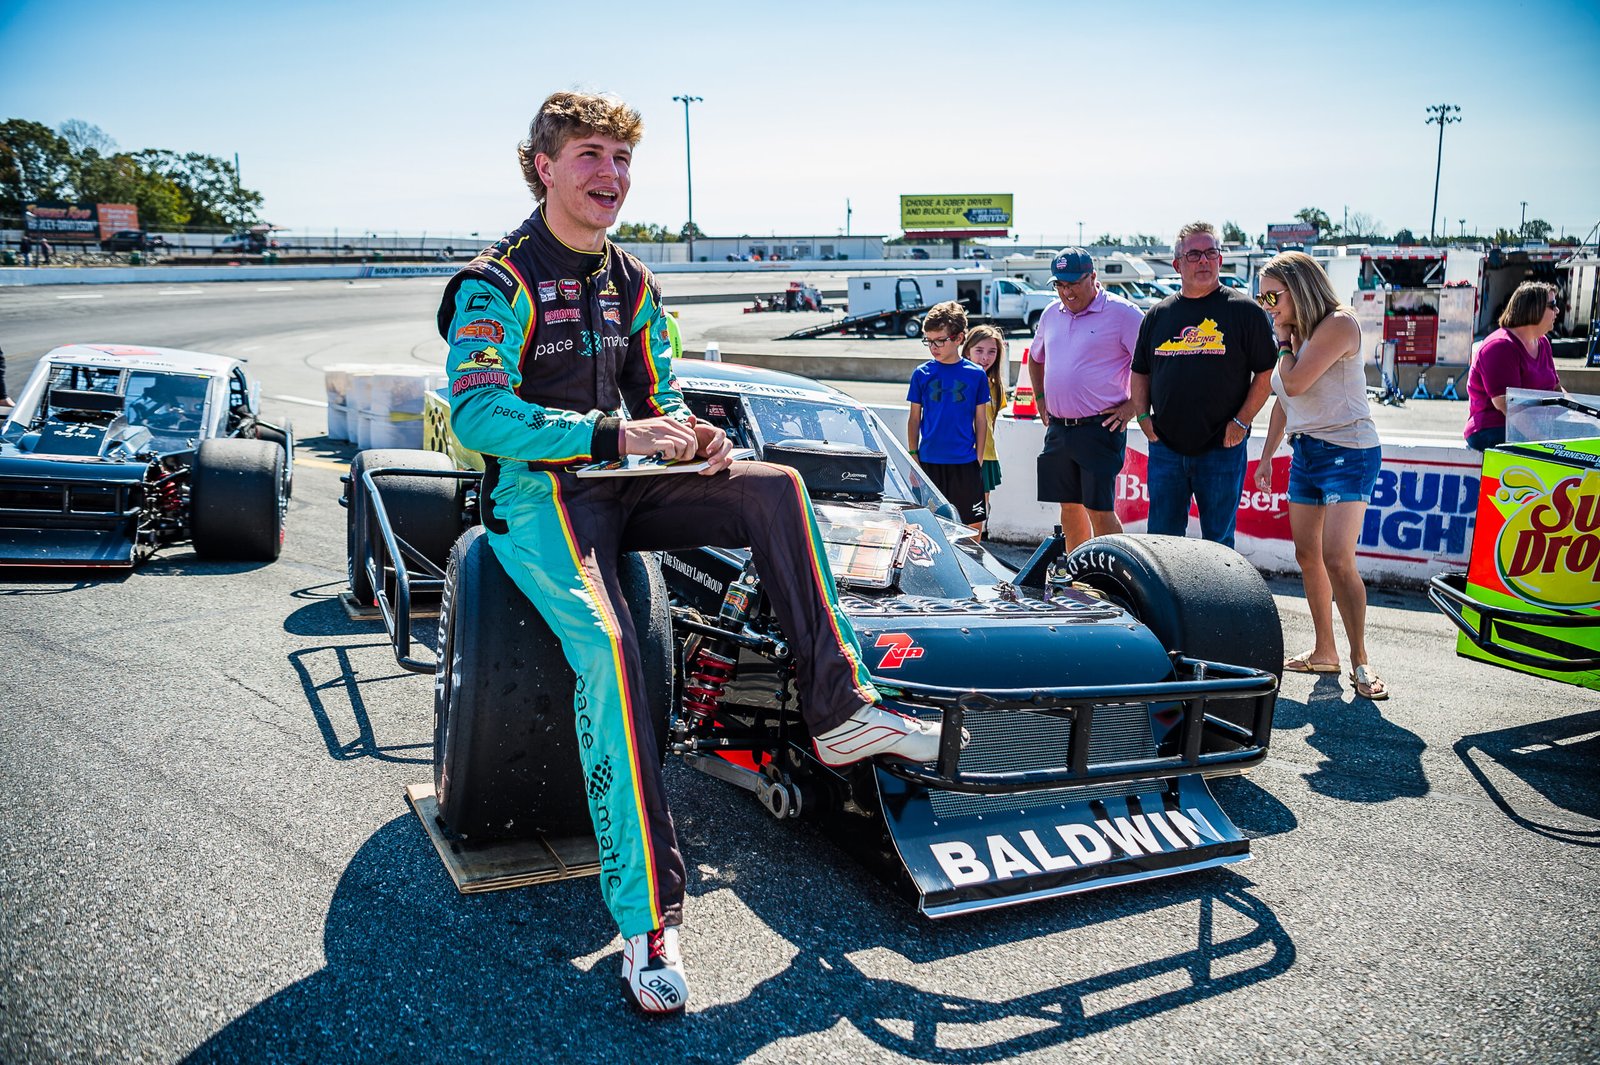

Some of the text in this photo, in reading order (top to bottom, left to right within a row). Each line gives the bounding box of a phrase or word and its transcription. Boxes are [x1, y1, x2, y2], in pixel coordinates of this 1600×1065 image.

[905, 199, 934, 207] CHOOSE
[943, 199, 966, 207] SOBER
[967, 198, 993, 206] DRIVER
[906, 207, 963, 216] AND BUCKLE UP
[401, 266, 430, 274] BOSTON
[534, 338, 574, 361] pace
[1184, 335, 1216, 344] RACING
[452, 371, 510, 396] MOHAWK
[686, 379, 807, 398] pace matic
[491, 404, 526, 421] pace
[1368, 469, 1481, 514] BUD
[1357, 508, 1477, 555] IGH
[663, 550, 723, 595] THE STANLEY LAW GROUP
[574, 674, 594, 751] pace
[597, 805, 626, 890] matic
[928, 807, 1226, 889] BALDWIN
[648, 978, 679, 1004] OMP
